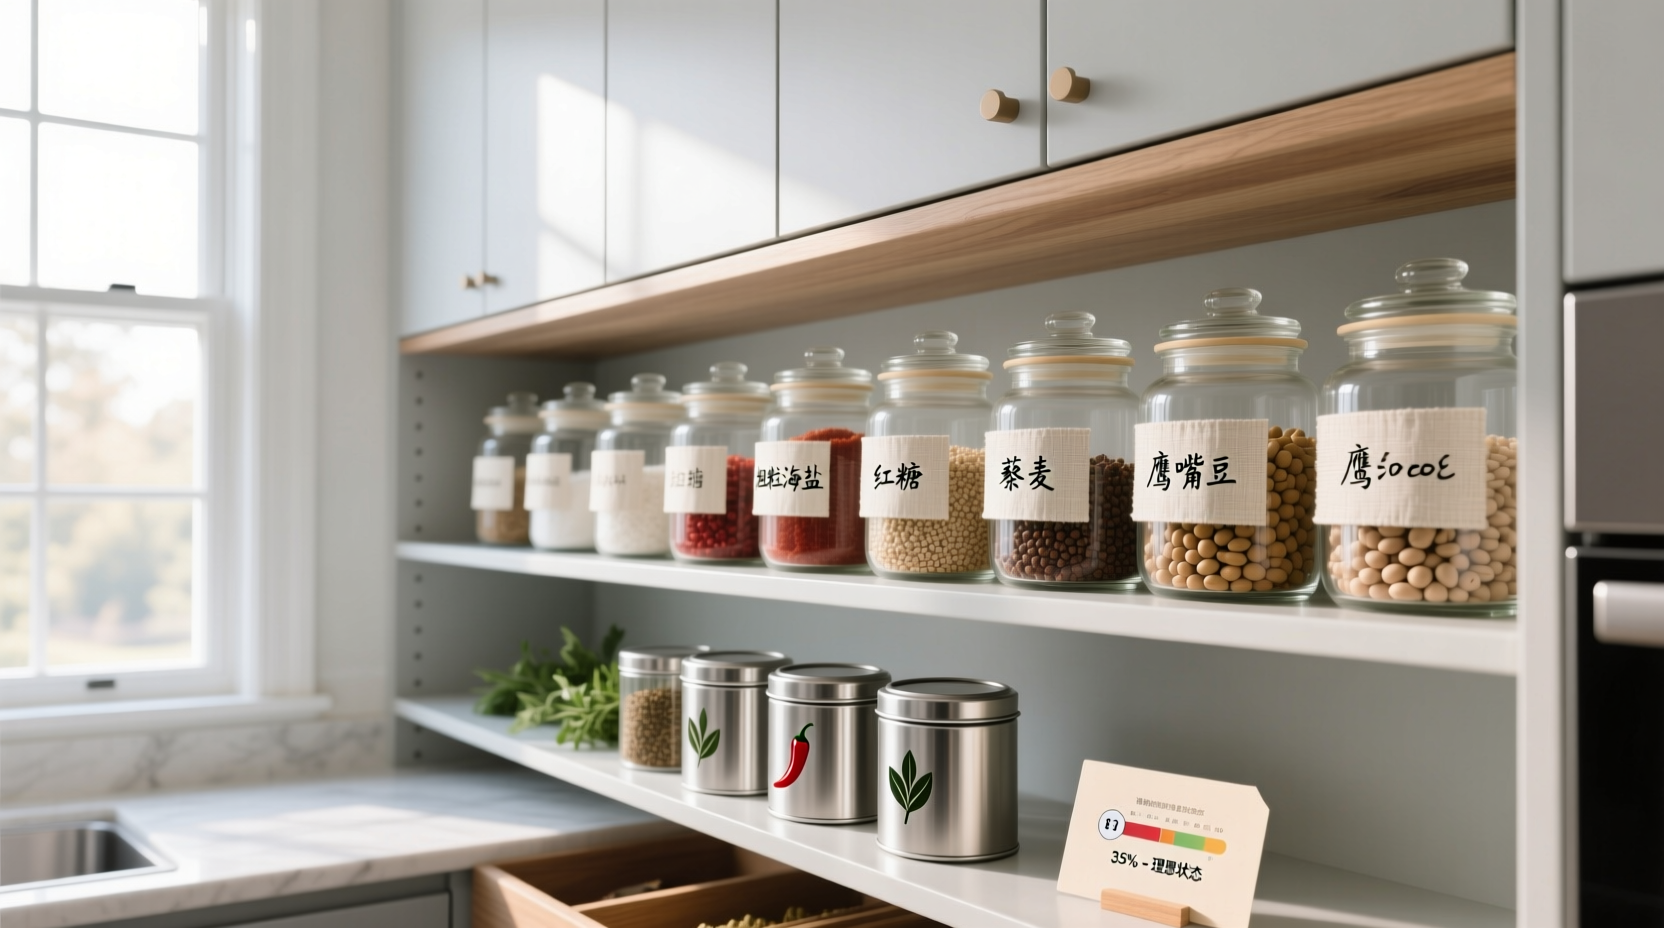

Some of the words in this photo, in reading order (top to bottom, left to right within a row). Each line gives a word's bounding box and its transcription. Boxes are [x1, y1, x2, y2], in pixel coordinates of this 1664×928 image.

[874, 462, 923, 490] 红糖
[1000, 456, 1054, 491] 藜麦
[1147, 451, 1237, 491] 鹰嘴豆
[1111, 850, 1138, 868] 35%
